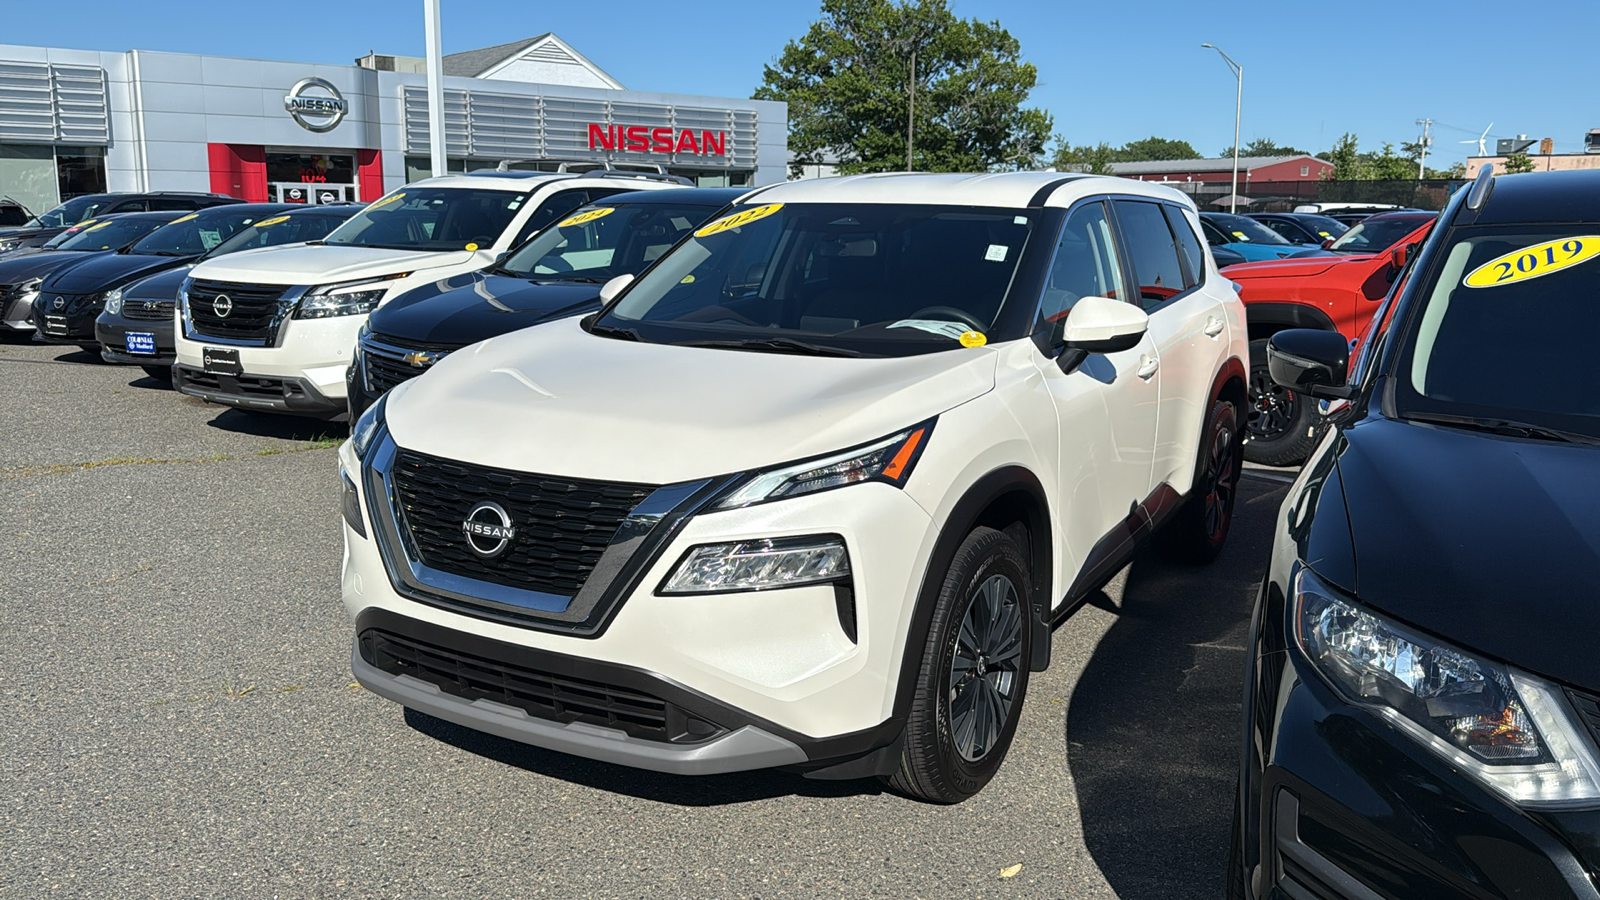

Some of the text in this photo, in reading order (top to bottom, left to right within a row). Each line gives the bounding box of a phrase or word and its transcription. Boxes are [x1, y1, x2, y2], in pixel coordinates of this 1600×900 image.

[291, 99, 343, 111] NISSAN
[587, 123, 725, 155] NISSAN
[299, 168, 327, 183] 104
[564, 209, 607, 225] 2024
[708, 206, 770, 233] 2022
[1493, 240, 1583, 282] 2019
[126, 335, 154, 344] COLONIAL
[463, 521, 513, 538] NISSAN
